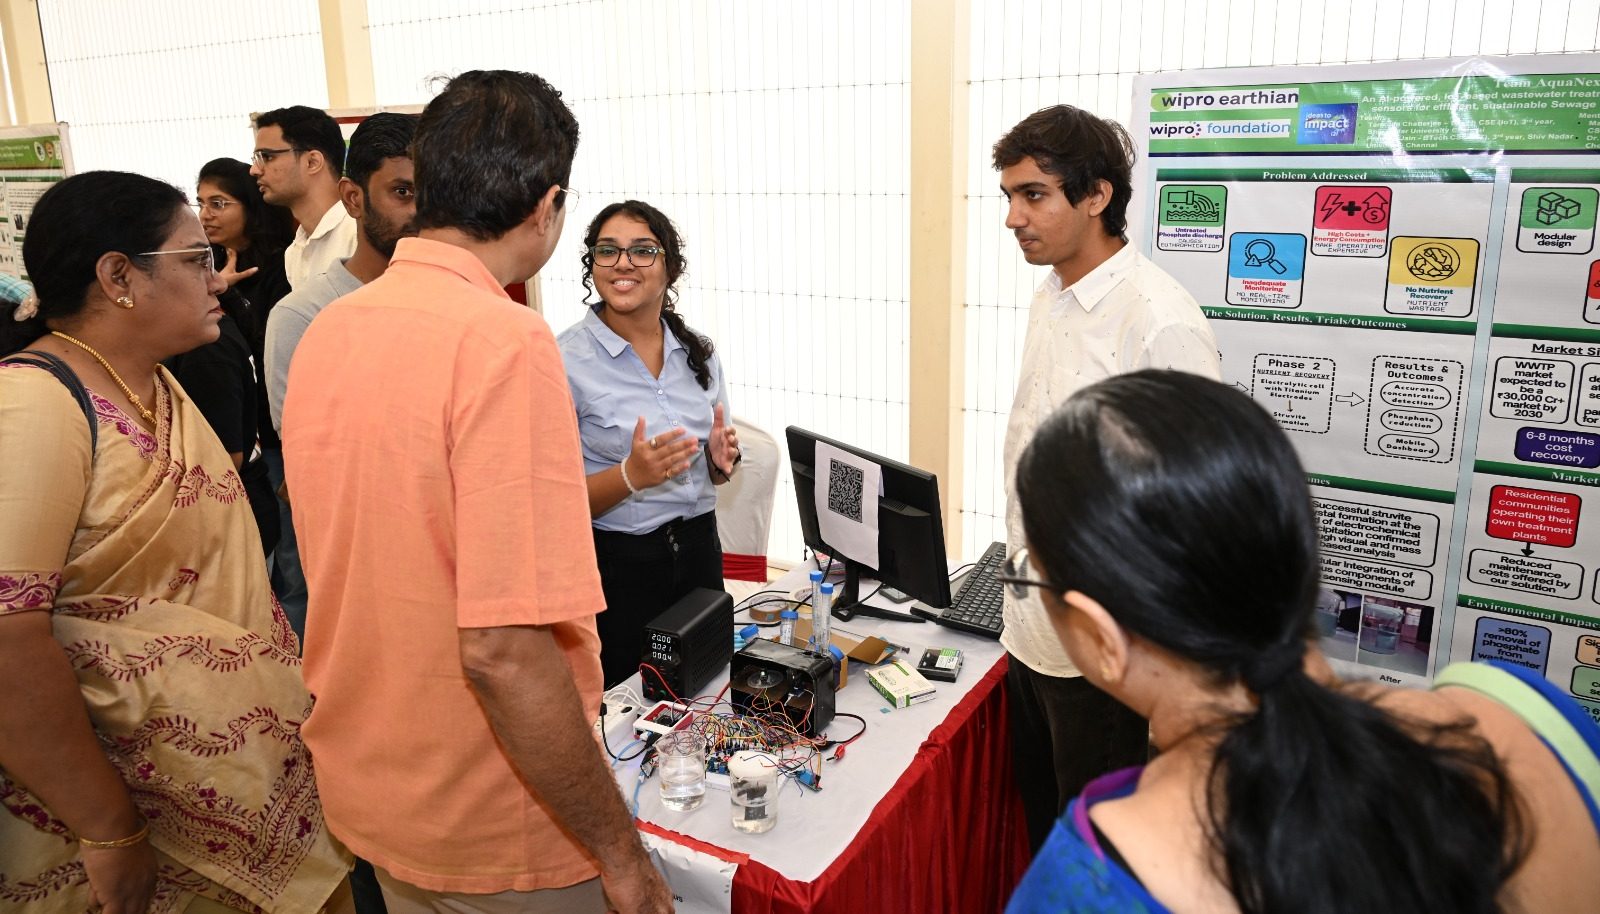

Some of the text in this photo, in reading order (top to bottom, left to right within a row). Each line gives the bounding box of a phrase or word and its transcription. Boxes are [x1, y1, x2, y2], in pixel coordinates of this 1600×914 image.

[1162, 91, 1299, 110] wipro earthian
[1483, 101, 1547, 110] sustainable
[1551, 101, 1596, 109] Sewage
[1150, 123, 1195, 137] wipro
[1207, 122, 1291, 134] foundation
[1304, 118, 1349, 130] impact
[1262, 172, 1367, 180] Problem Addressed
[1534, 232, 1577, 241] Modular
[1537, 240, 1572, 248] design
[1418, 287, 1453, 295] Nutrient
[1410, 293, 1448, 301] Recovery
[1202, 309, 1223, 318] The
[1315, 315, 1407, 329] Trials/Outcomes
[1532, 343, 1583, 355] Market
[1269, 359, 1320, 370] Phase 2
[1385, 361, 1434, 372] Results
[1515, 361, 1556, 370] WWTP
[1388, 371, 1444, 382] Outcomes
[1514, 370, 1553, 379] market
[1394, 384, 1435, 392] Accurate
[1500, 377, 1566, 388] expected to
[1285, 387, 1319, 395] Titanium
[1383, 391, 1445, 400] concentration
[1520, 386, 1534, 394] be
[1392, 398, 1434, 406] detection
[1544, 396, 1565, 404] Cr+
[1502, 401, 1557, 413] market by
[1274, 412, 1306, 420] Struvite
[1388, 413, 1434, 422] Phosphate
[1514, 409, 1543, 418] 2030
[1389, 420, 1431, 429] reduction
[1583, 416, 1599, 424] for
[1526, 432, 1595, 446] 6-8 months
[1386, 444, 1434, 454] Dashboard
[1545, 444, 1573, 453] cost
[1531, 451, 1585, 464] recovery
[1552, 471, 1599, 485] Market
[1505, 489, 1567, 504] Residential
[1312, 501, 1412, 521] Successful struvite
[1498, 499, 1571, 514] communities
[1314, 510, 1336, 518] ystal
[1338, 512, 1389, 525] formation
[1404, 522, 1421, 531] the
[1493, 508, 1574, 525] operating their
[1322, 518, 1333, 526] of
[1335, 519, 1421, 539] electrochemical
[1492, 518, 1572, 534] own treatment
[1317, 525, 1364, 538] cipitation
[1365, 532, 1420, 546] confirmed
[1512, 531, 1547, 542] plants
[1339, 536, 1368, 547] visual
[1370, 540, 1390, 550] and
[1392, 544, 1421, 555] mass
[1354, 547, 1396, 559] analysis
[1501, 556, 1552, 570] Reduced
[1344, 561, 1400, 577] Integration
[1402, 570, 1414, 579] of
[1489, 562, 1562, 579] maintenance
[1335, 568, 1401, 585] components
[1402, 578, 1415, 587] of
[1479, 568, 1571, 589] costs offered by
[1322, 574, 1363, 587] sensing
[1364, 580, 1405, 593] module
[1511, 580, 1556, 593] solution
[1467, 598, 1600, 629] Environmental Impac
[1498, 627, 1528, 638] >80%
[1484, 632, 1541, 648] removal of
[1482, 639, 1540, 655] phosphate
[1497, 648, 1522, 659] from
[1380, 674, 1402, 684] After
